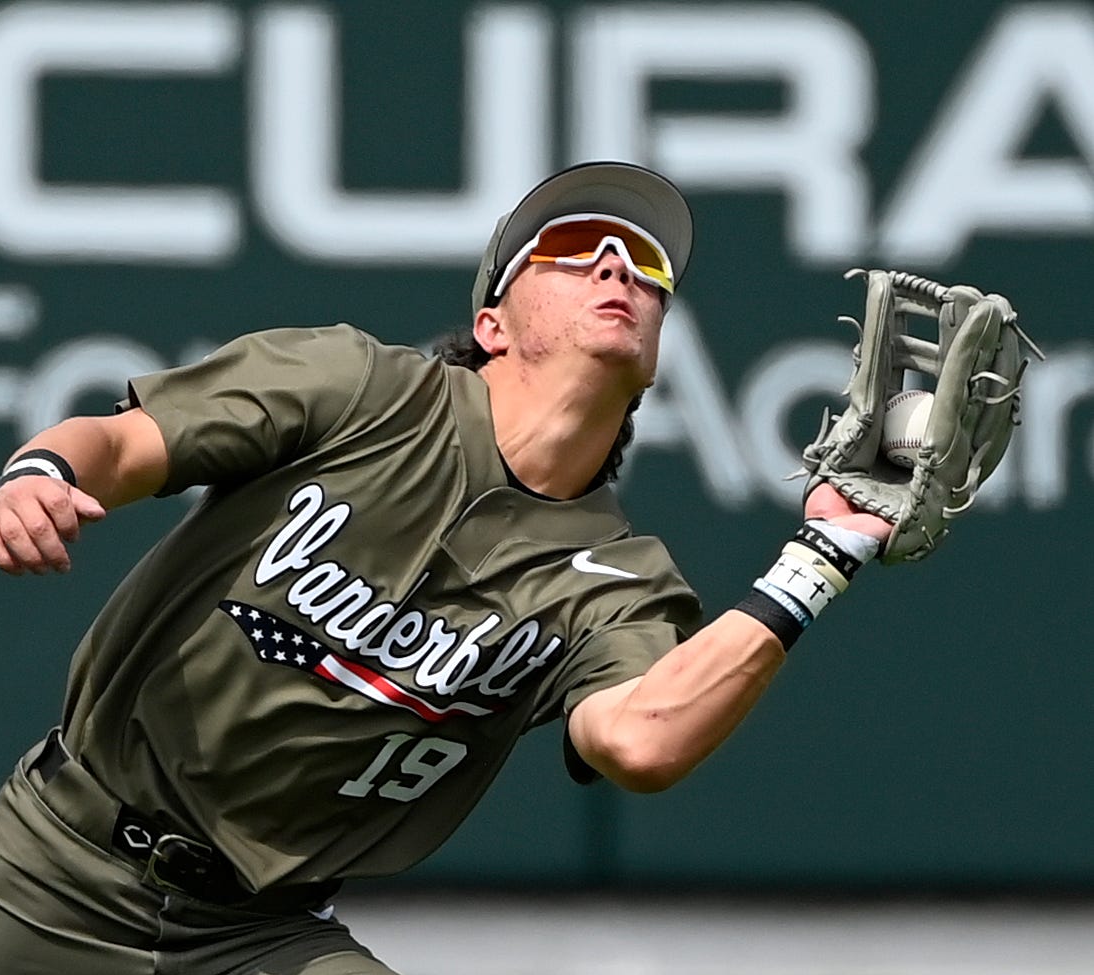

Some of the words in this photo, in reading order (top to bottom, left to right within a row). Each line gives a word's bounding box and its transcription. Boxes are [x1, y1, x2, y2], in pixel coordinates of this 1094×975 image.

[608, 298, 1094, 510] Acr
[253, 482, 563, 698] Vanderblt
[337, 732, 468, 803] 19
